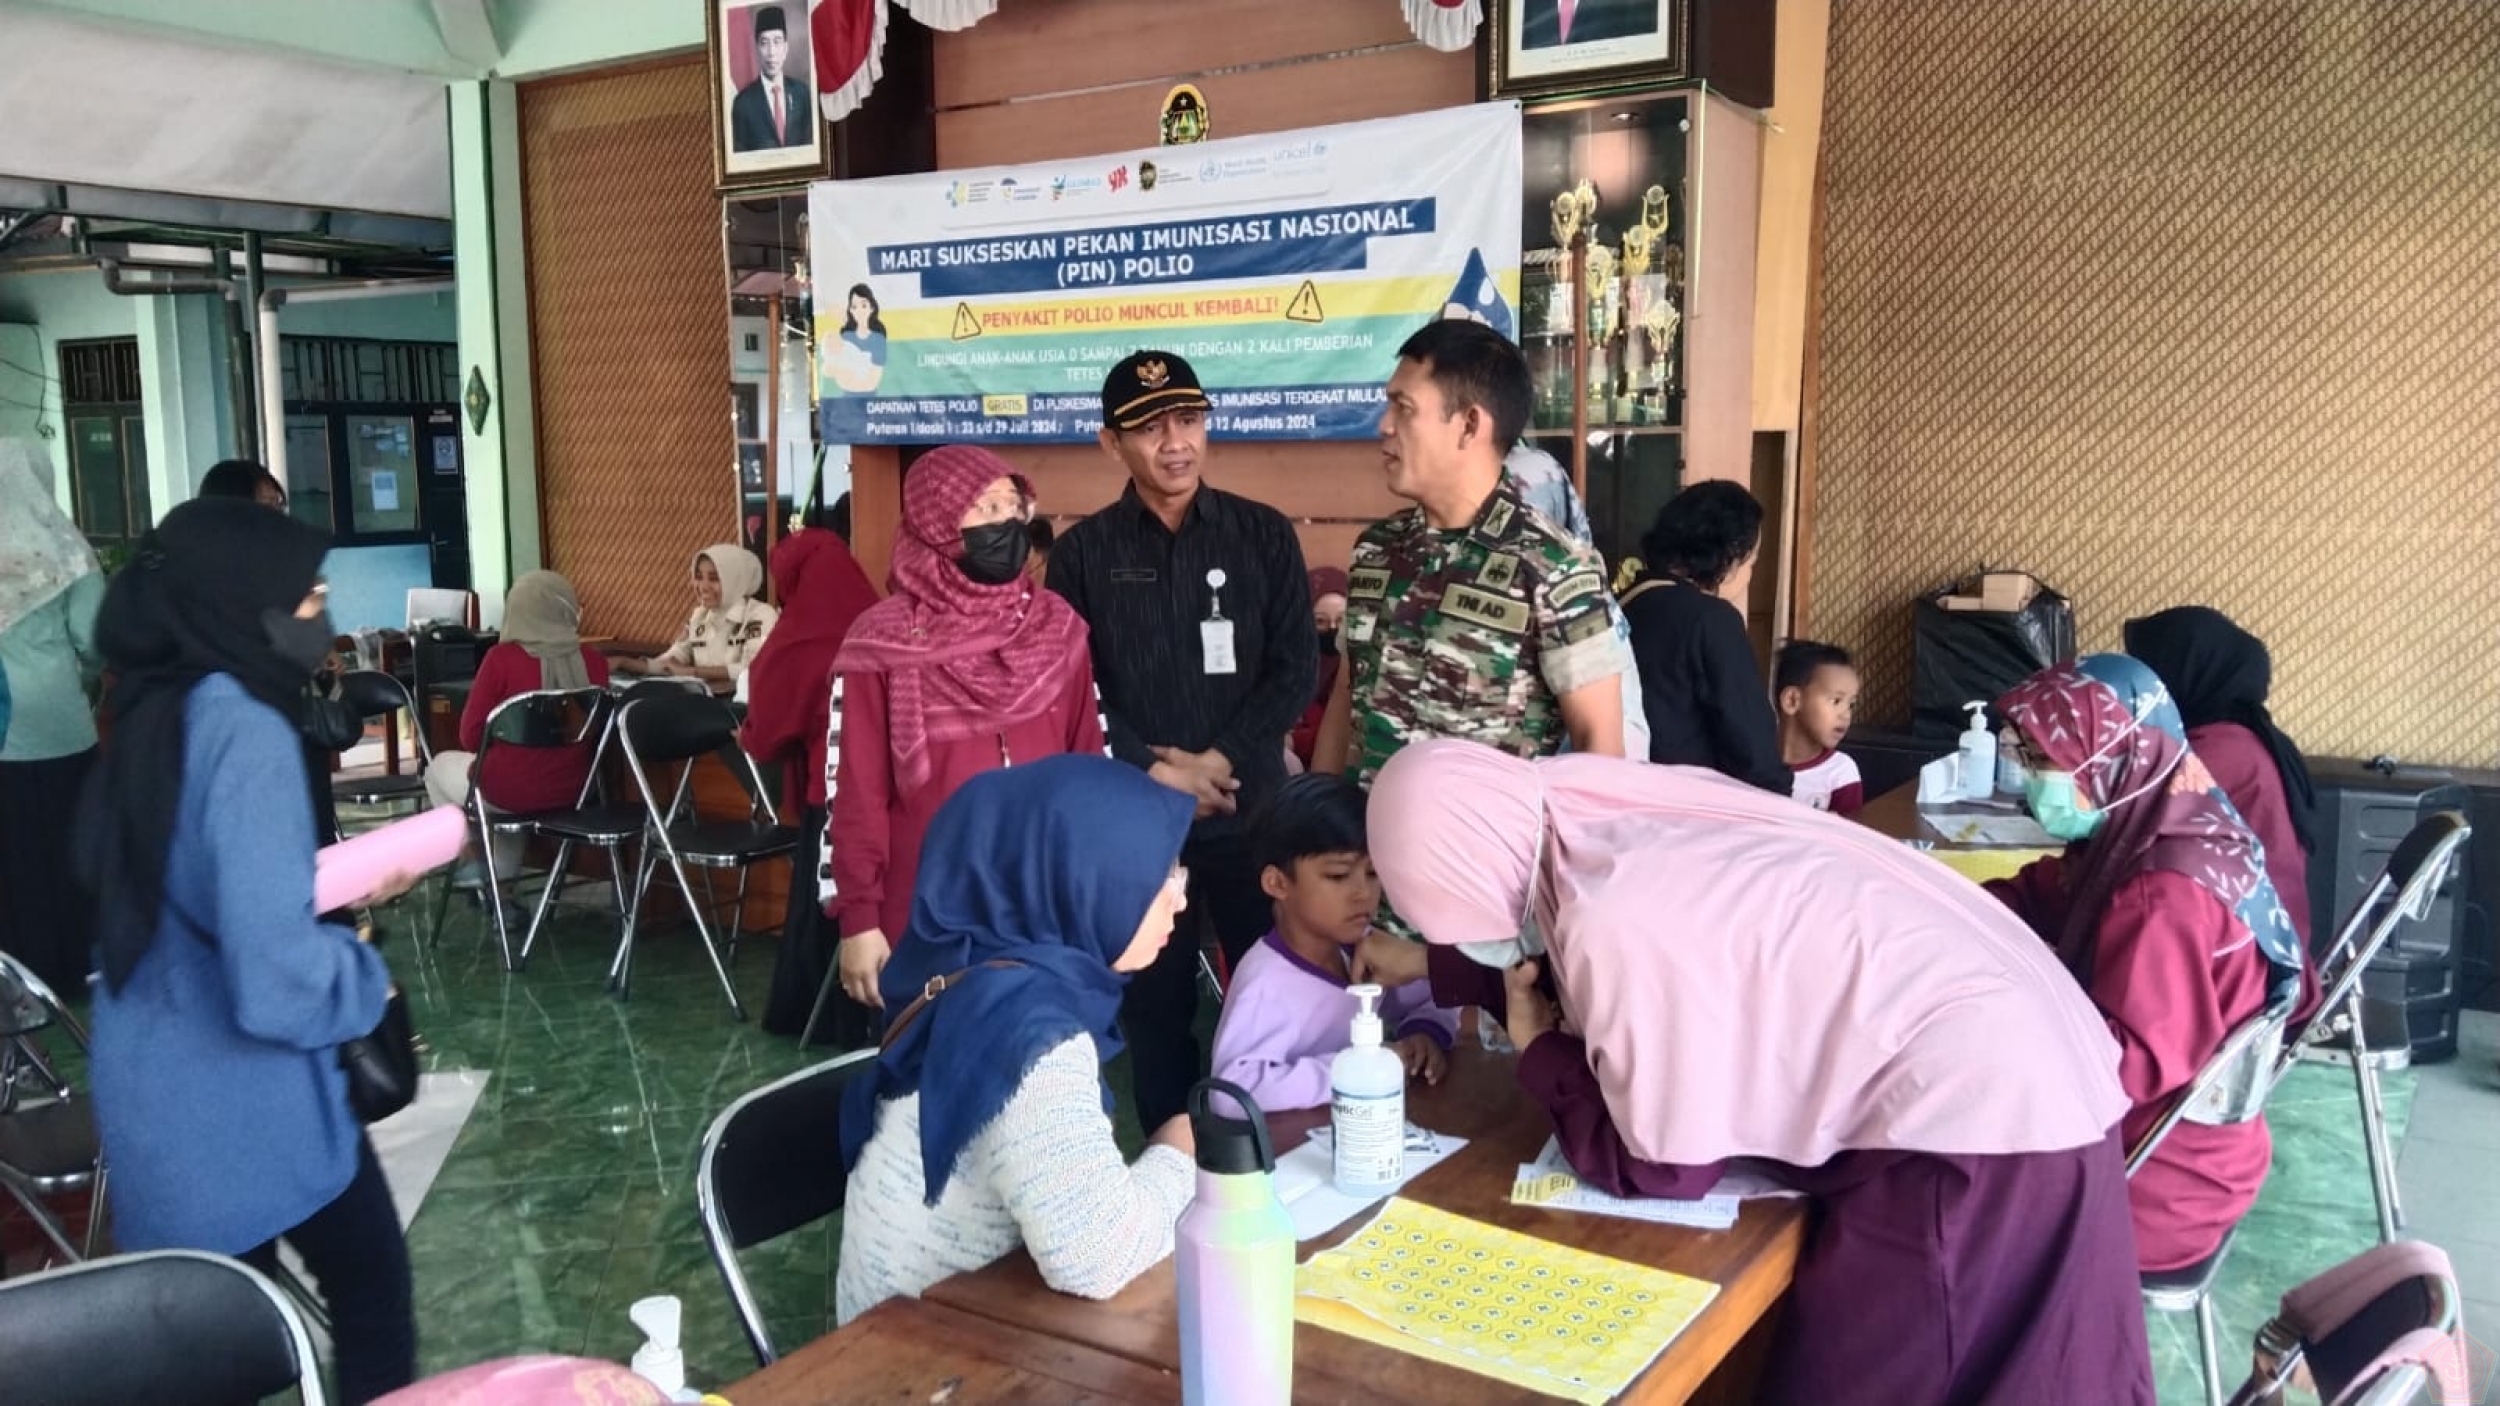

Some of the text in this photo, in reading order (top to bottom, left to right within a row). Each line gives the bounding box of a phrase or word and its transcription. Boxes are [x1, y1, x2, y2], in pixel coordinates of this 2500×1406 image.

[880, 206, 1414, 270] MARI SUKSESKAN PEKAN IMUNISASI NASIONAL
[1057, 254, 1194, 287] (PIN) POLIO
[982, 296, 1278, 328] PENYAKIT POLIO MUNCUL KEMBALI!
[970, 349, 1034, 365] ANAK-ANAK
[1038, 348, 1066, 363] USIA
[1080, 345, 1124, 362] SAMPAI
[1188, 340, 1242, 357] DENGAN
[1247, 338, 1255, 354] 2
[1260, 337, 1290, 353] KALI
[1295, 333, 1373, 351] PEMBERIAN
[1064, 366, 1102, 382] TETES
[918, 400, 946, 414] TETES
[948, 399, 978, 413] POLIO
[987, 399, 1023, 412] GRATIS
[1033, 398, 1045, 411] DI
[1046, 396, 1104, 411] PUSKESMA
[1222, 391, 1281, 407] IMUNISASI
[1283, 387, 1345, 405] TERDEKAT
[1215, 416, 1229, 432] 12
[1232, 415, 1284, 434] Agustus
[1286, 413, 1317, 430] 2024
[1457, 593, 1506, 620] TNI AD
